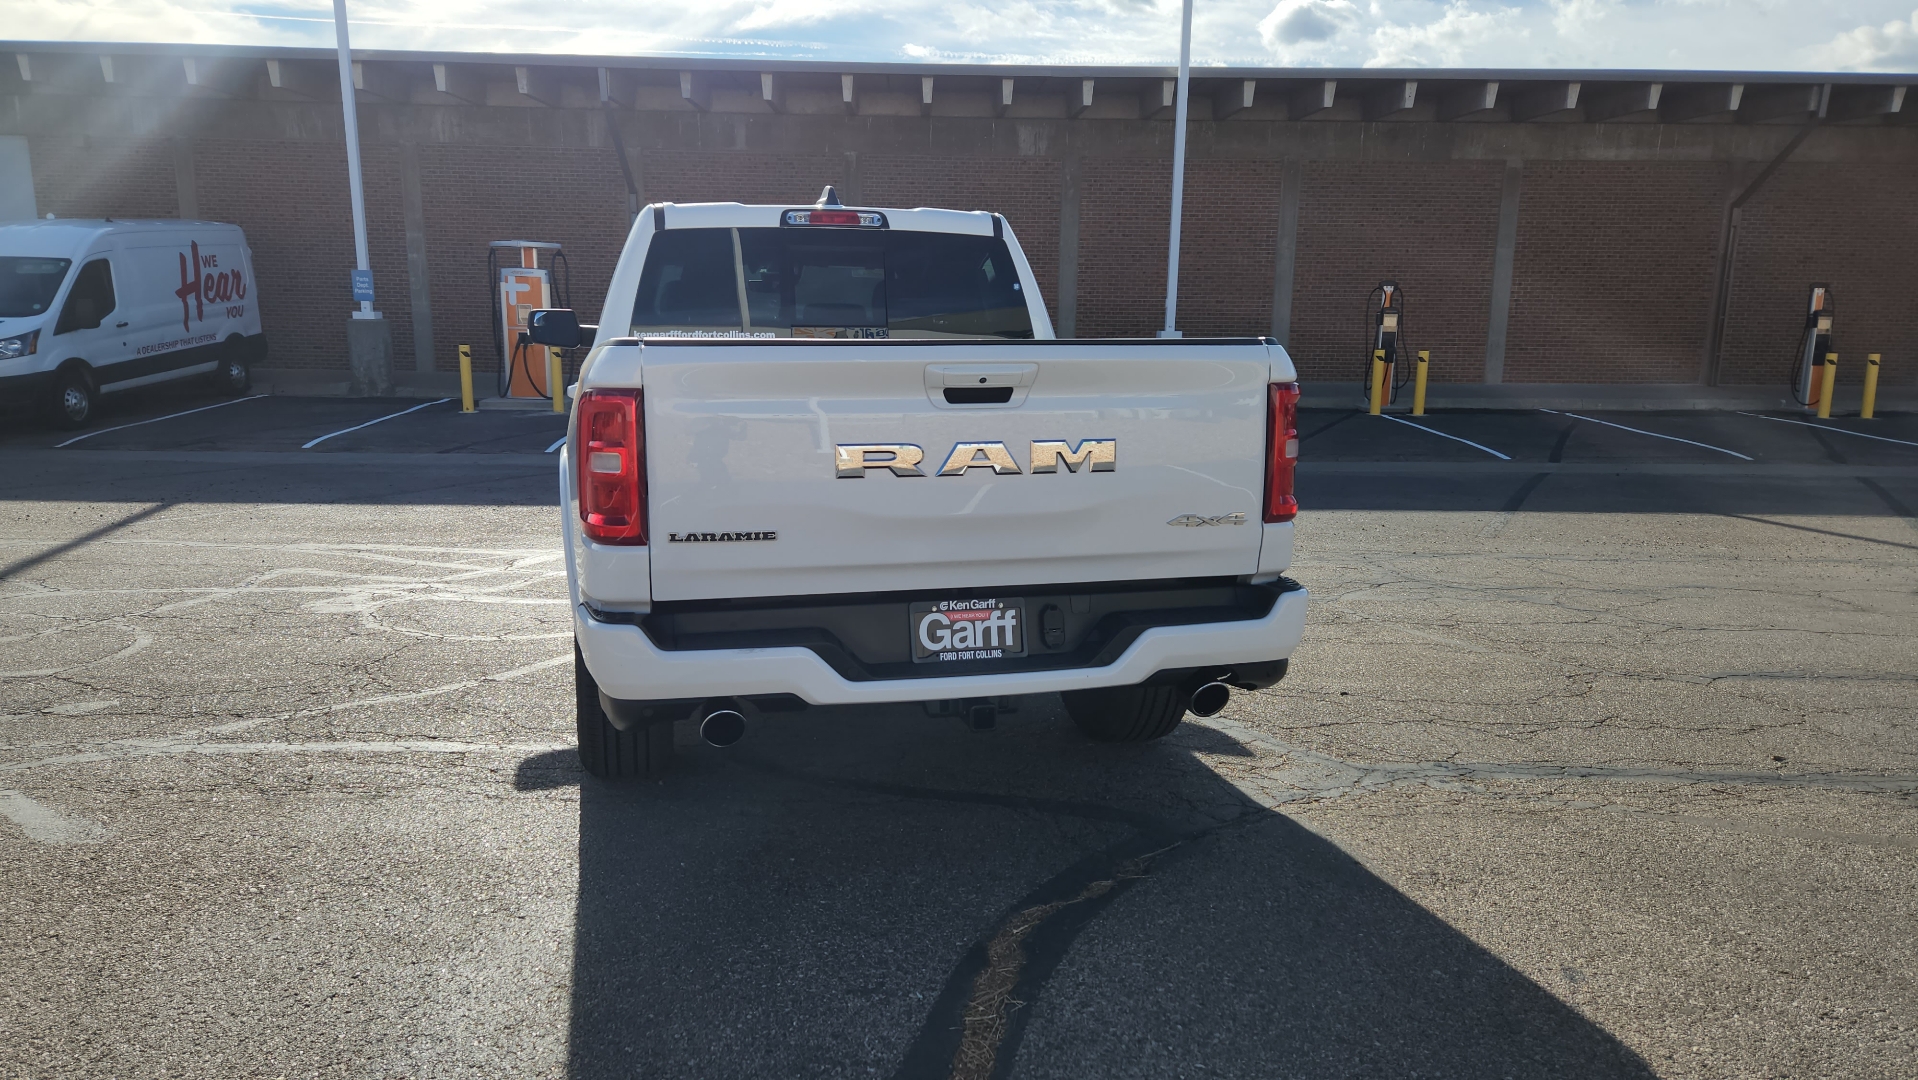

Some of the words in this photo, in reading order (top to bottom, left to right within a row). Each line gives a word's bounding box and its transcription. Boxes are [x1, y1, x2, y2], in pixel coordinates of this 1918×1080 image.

[201, 255, 218, 268] WE
[175, 240, 246, 333] Hear
[226, 305, 244, 319] YOU
[136, 347, 141, 356] A
[142, 341, 179, 355] DEALERSHIP
[180, 337, 194, 347] THAT
[194, 333, 217, 344] LISTENS
[835, 438, 1116, 479] RAM
[668, 531, 777, 543] LARAMIE
[949, 600, 970, 611] Ken
[970, 599, 996, 610] Garff
[919, 609, 1016, 651] Garff
[940, 652, 957, 661] FORD
[958, 650, 975, 660] FORT
[976, 649, 1002, 659] COLLINS
